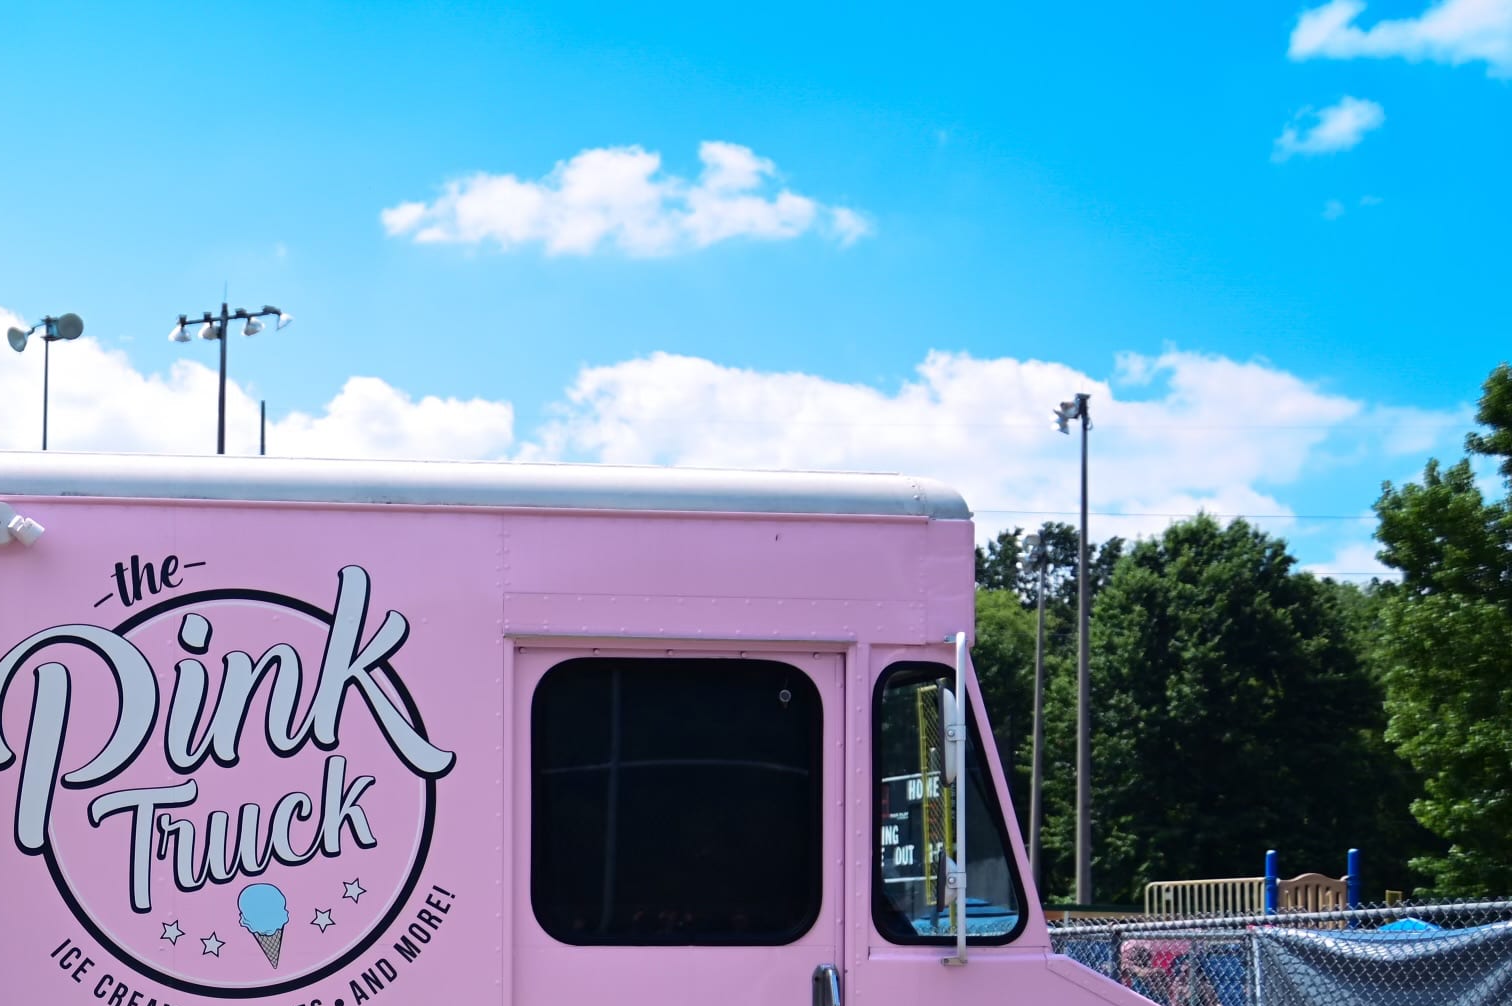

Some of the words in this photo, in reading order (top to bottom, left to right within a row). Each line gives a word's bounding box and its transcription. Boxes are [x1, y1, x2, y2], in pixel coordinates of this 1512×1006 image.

[87, 755, 378, 914] Truck
[895, 845, 915, 866] OUT
[50, 938, 96, 985] ICE
[348, 958, 399, 1006] AND
[392, 884, 456, 964] MORE!
